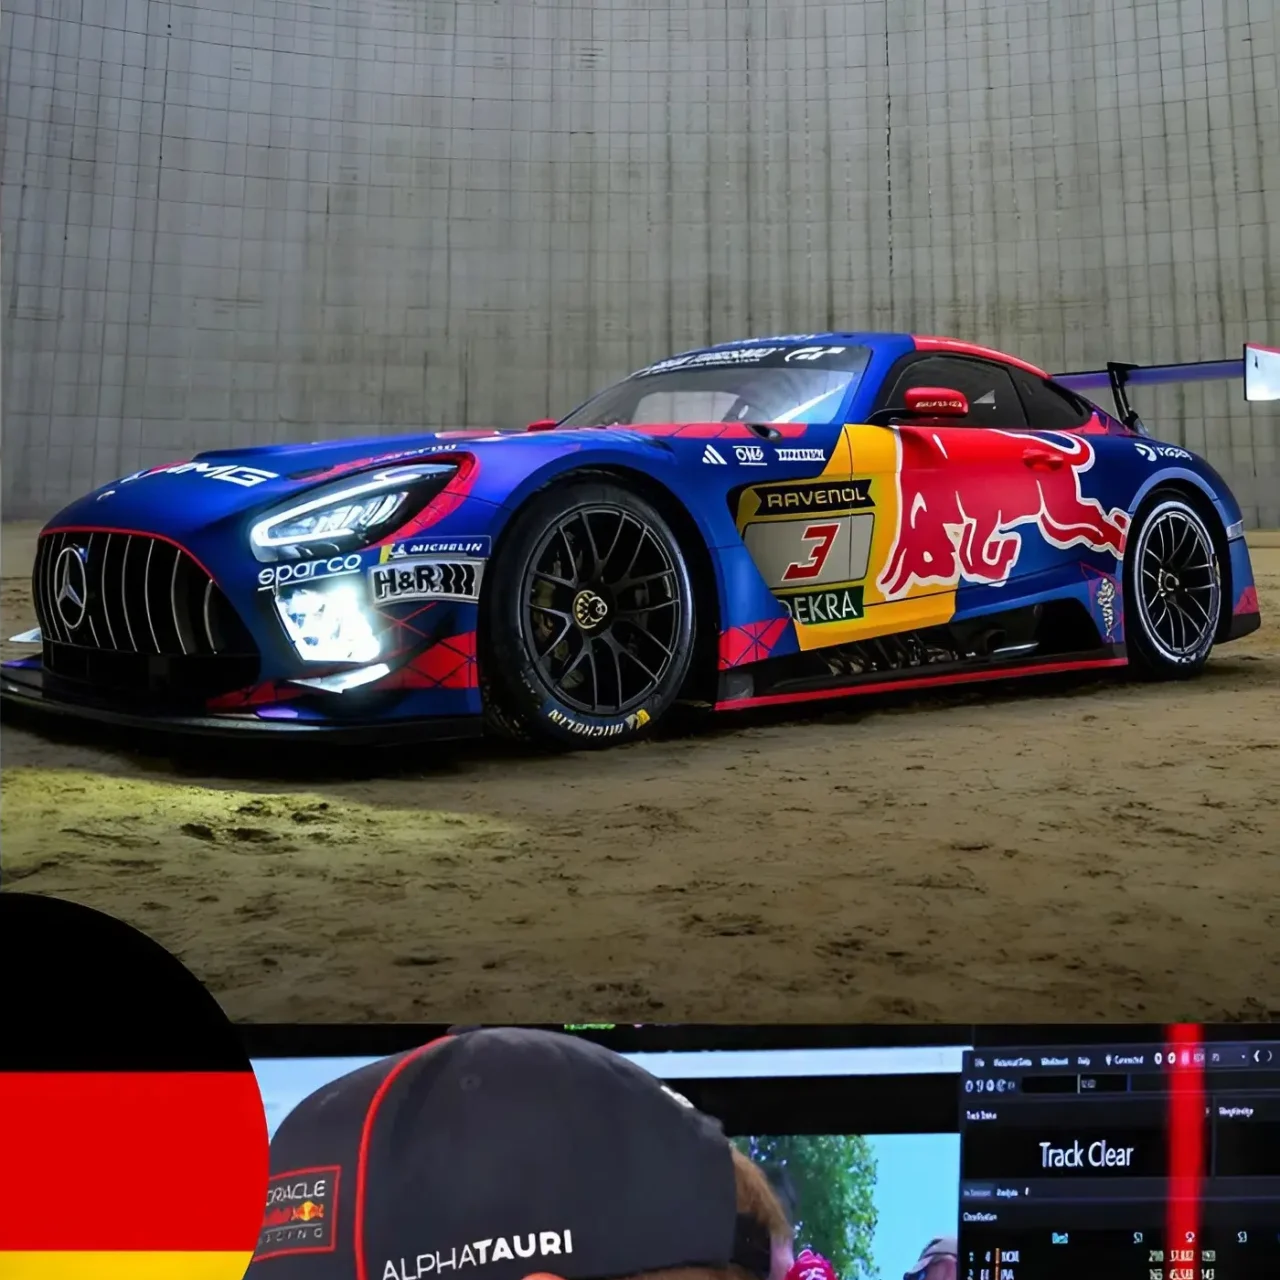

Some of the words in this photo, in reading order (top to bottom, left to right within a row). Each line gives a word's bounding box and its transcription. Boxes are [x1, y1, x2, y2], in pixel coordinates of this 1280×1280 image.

[410, 542, 483, 553] MICHELIN
[781, 523, 841, 581] 3
[257, 554, 363, 592] sparco
[373, 563, 437, 598] H&R
[1039, 1140, 1083, 1168] Track
[1088, 1140, 1134, 1167] Clear
